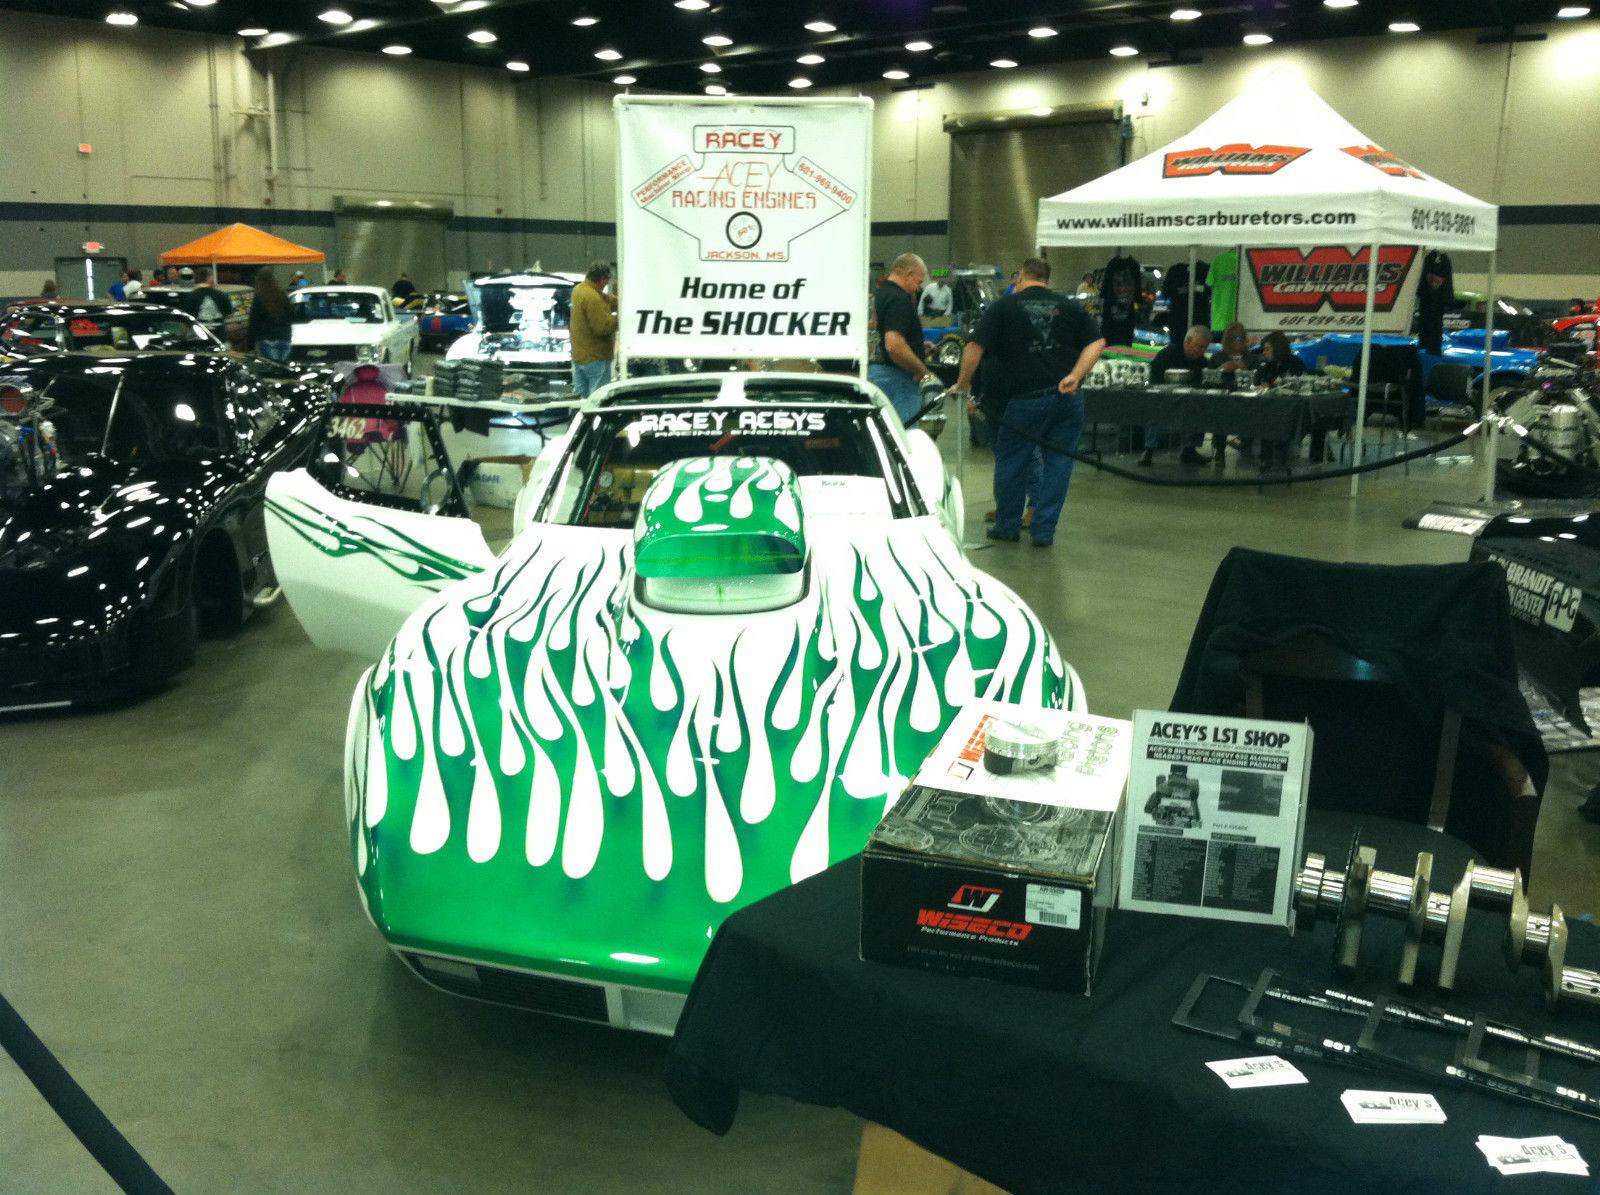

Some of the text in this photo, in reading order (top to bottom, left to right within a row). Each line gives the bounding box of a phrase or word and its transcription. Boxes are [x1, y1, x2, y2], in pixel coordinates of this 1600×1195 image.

[706, 132, 783, 148] RACEY
[1171, 152, 1294, 166] WILLIAMS
[696, 159, 784, 193] ACEY
[671, 191, 817, 209] RACING ENGINES
[1056, 210, 1357, 230] www.williamscarburetors.com
[1260, 262, 1402, 284] WILLIAMS
[680, 276, 807, 300] Home of
[1272, 282, 1387, 294] Carburetos
[636, 310, 851, 336] The SHOCKER
[637, 411, 728, 431] RACEY
[1149, 721, 1208, 742] ACEY'S
[1212, 725, 1239, 744] LS1
[1243, 729, 1291, 749] SHOP
[920, 926, 1019, 947] Performance Products
[1245, 1059, 1284, 1072] Aceys
[1389, 1096, 1433, 1110] Aceys
[1521, 1144, 1567, 1157] Aceys
